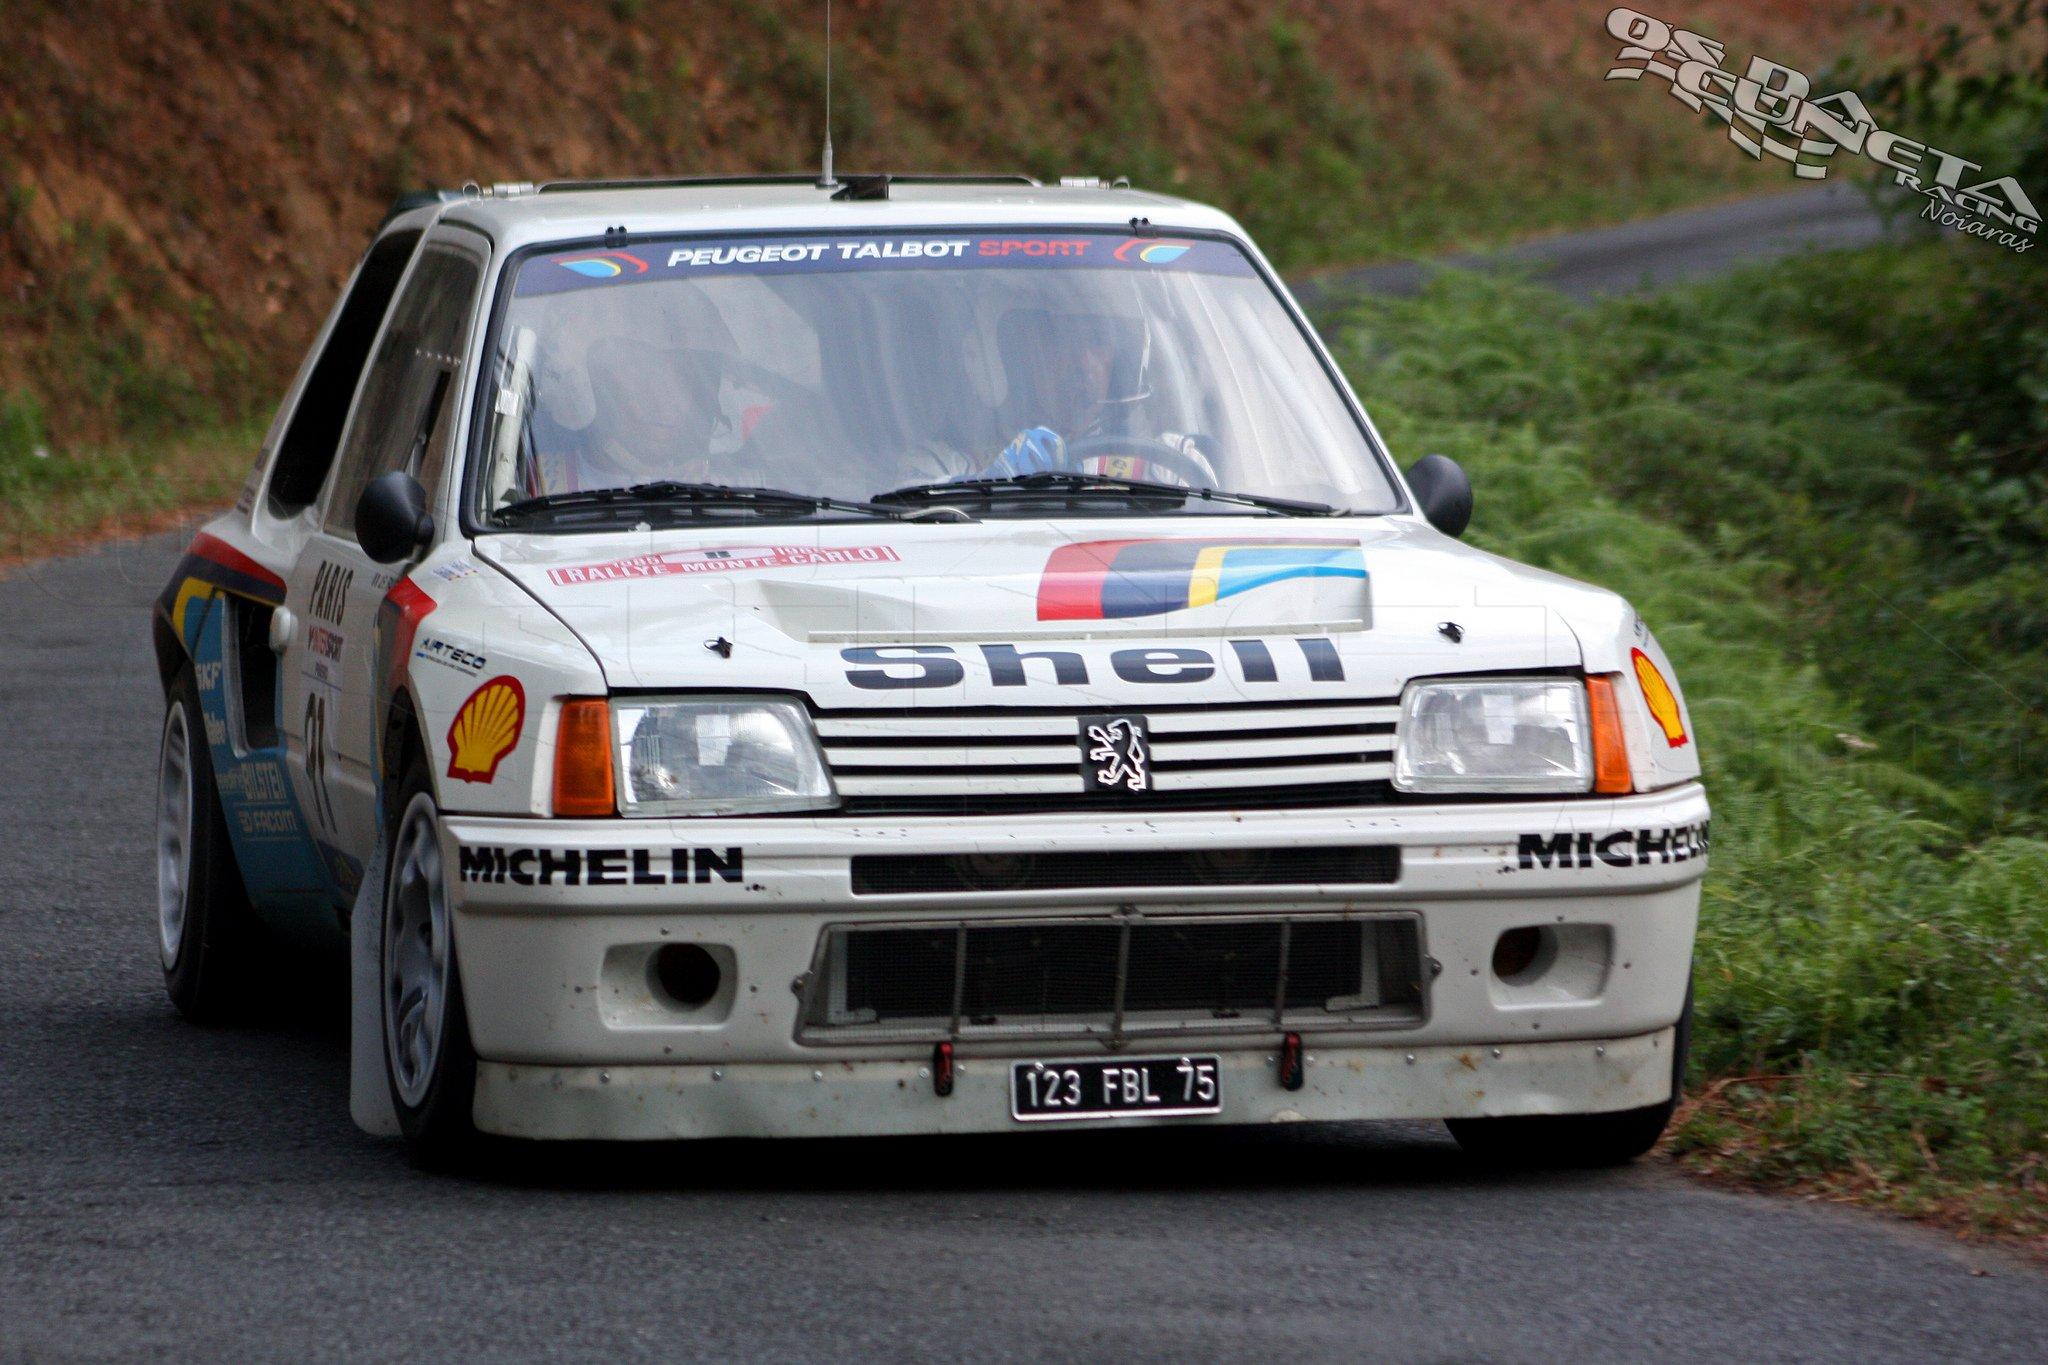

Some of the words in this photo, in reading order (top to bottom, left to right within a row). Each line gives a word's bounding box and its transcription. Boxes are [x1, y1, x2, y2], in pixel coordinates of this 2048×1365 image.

[667, 243, 830, 267] PEUGEOT
[837, 240, 971, 260] TALBOT
[977, 239, 1092, 257] SPORT
[309, 560, 354, 627] PARIS
[564, 565, 668, 584] RALLYE
[840, 637, 1346, 690] Shell
[458, 846, 744, 886] MICHELIN
[1026, 1069, 1081, 1107] 123
[1102, 1068, 1161, 1104] FBL
[1176, 1065, 1216, 1102] 75
